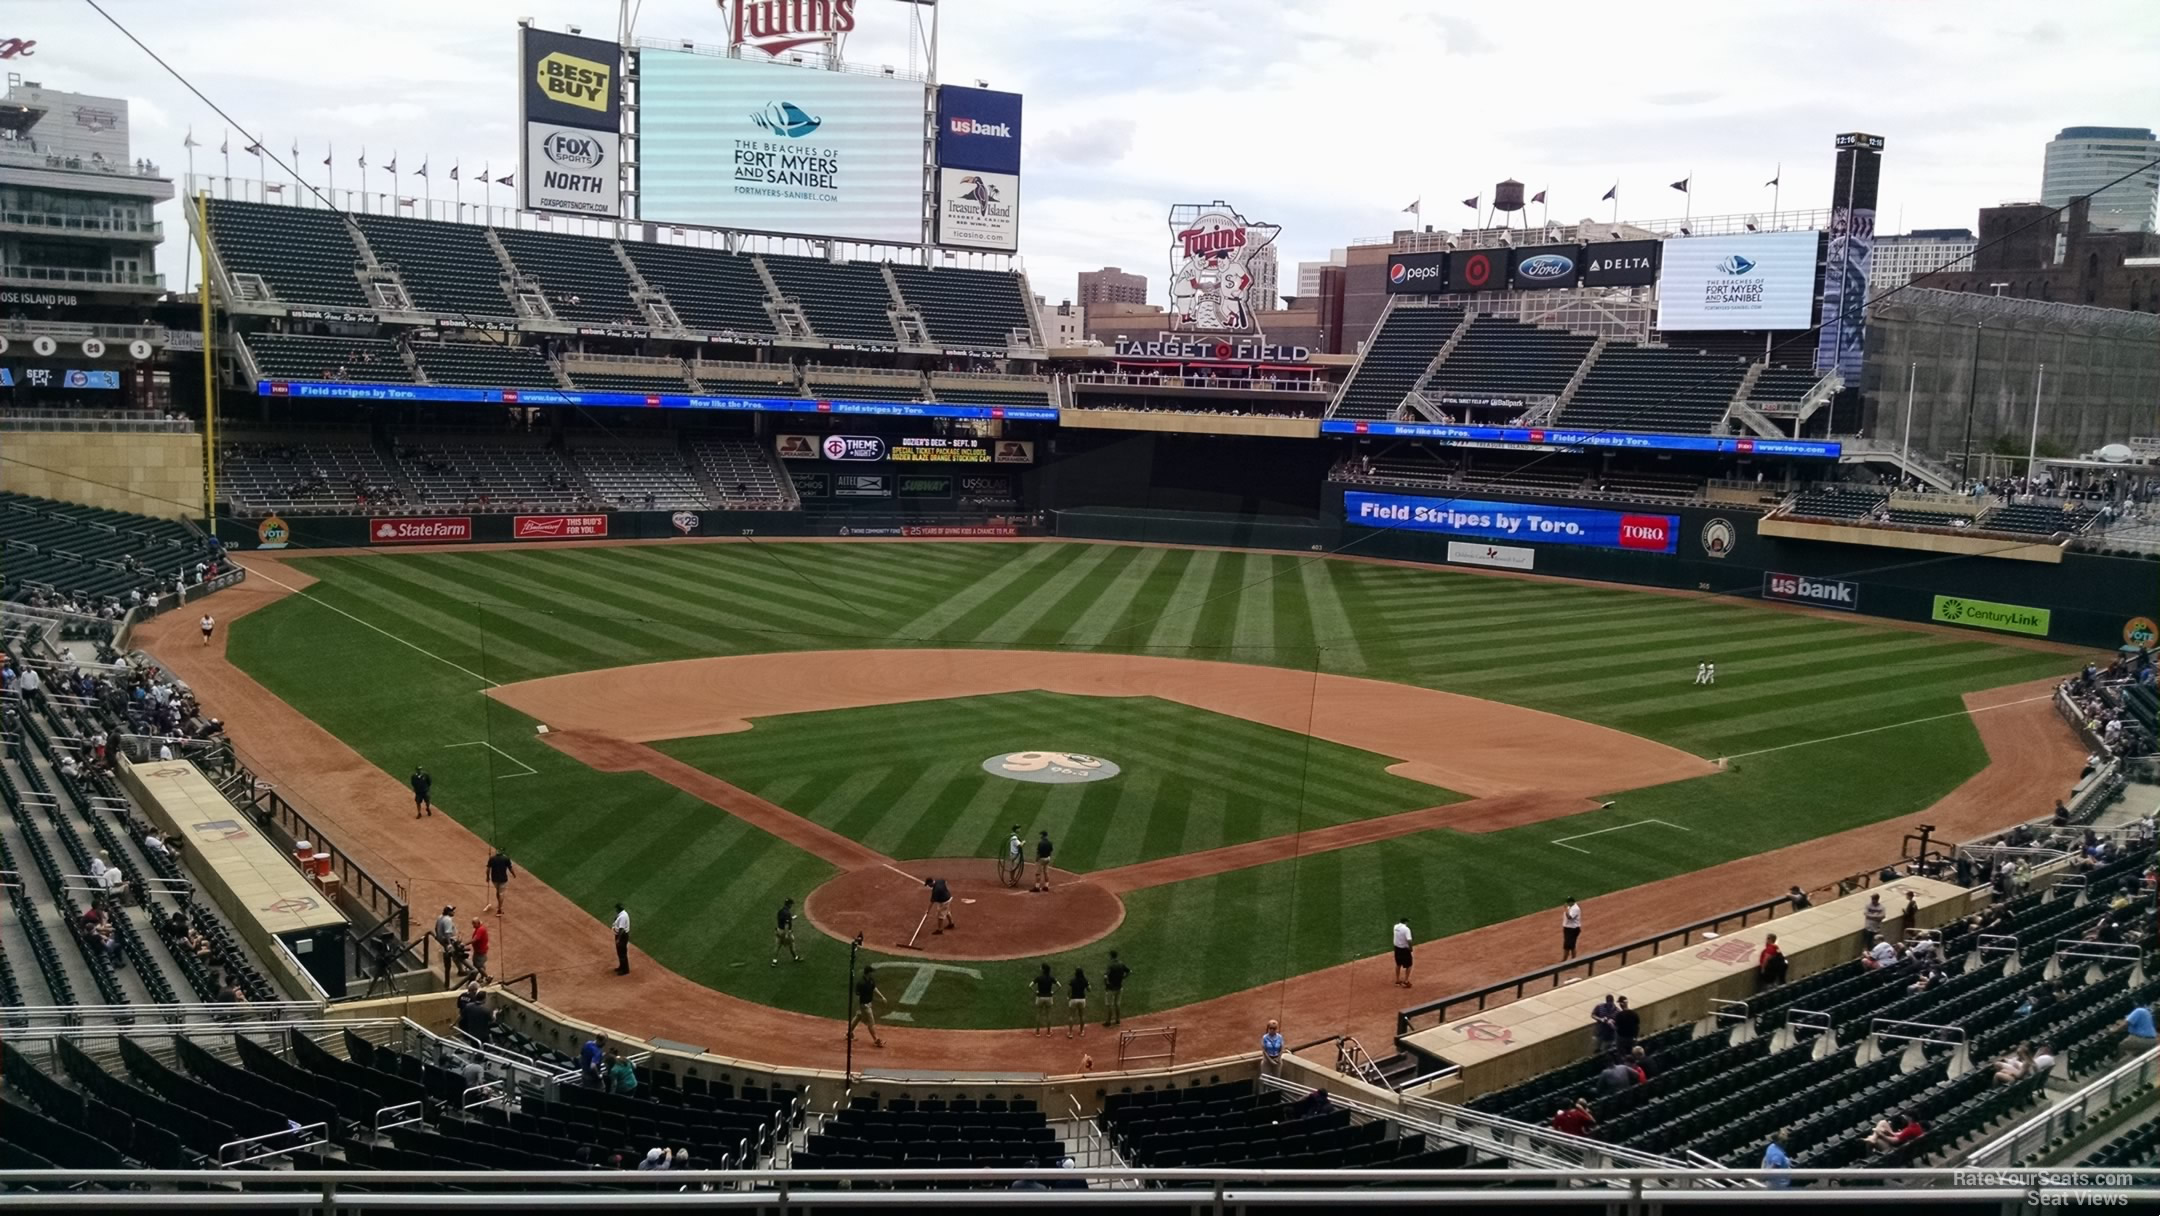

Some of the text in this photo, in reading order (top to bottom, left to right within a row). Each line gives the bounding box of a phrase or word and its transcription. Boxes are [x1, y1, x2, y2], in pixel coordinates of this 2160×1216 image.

[547, 60, 607, 88] BEST
[549, 76, 603, 102] BUY
[1837, 135, 1856, 145] 12:16
[556, 136, 591, 157] FOX
[735, 139, 838, 158] THE BEACHES OF
[556, 153, 592, 165] SPORTS
[735, 150, 838, 175] FORT MYERS
[543, 170, 603, 194] NORTH
[734, 166, 838, 190] AND SANIBEL
[734, 185, 838, 202] FORTMYERS-SANIBEL.COM
[540, 197, 608, 213] FOXSPORTSNORTH.COM
[947, 199, 1011, 218] Treasure Island
[953, 230, 1003, 241] ticasino.com
[1177, 224, 1248, 259] Twins
[1528, 260, 1562, 276] Ford
[1604, 258, 1650, 270] DELTA
[1407, 264, 1439, 281] pepsi
[1706, 284, 1764, 294] FORT MYERS
[21, 293, 56, 305] ISLAND
[58, 295, 77, 306] PUB
[1722, 294, 1763, 303] SANIBEL
[41, 341, 48, 352] 6
[87, 343, 100, 353] 29
[138, 344, 144, 355] 3
[1115, 340, 1311, 361] TARGET FIELD
[26, 368, 53, 379] SEPT.
[301, 386, 329, 395] Field
[332, 387, 372, 398] stripes
[373, 387, 386, 398] by
[388, 389, 416, 398] Toro.
[689, 399, 764, 409] Mow like the Pros.
[839, 404, 860, 412] Field
[861, 405, 891, 414] stripes
[893, 406, 902, 415] by
[903, 406, 925, 414] Toro.
[1415, 427, 1431, 435] like
[1448, 429, 1470, 437] Pros.
[846, 439, 879, 452] THEME
[953, 439, 970, 447] SEPT.
[971, 440, 978, 448] 10
[1553, 434, 1650, 446] Field stripes by Toro.
[1759, 444, 1825, 454] www.toro.com
[901, 479, 948, 491] SUBWAY
[567, 517, 602, 526] THIS BUD'S
[685, 516, 698, 526] 29
[1360, 502, 1585, 536] Field Stripes by Toro.
[567, 526, 596, 534] FOR YOU.
[911, 527, 921, 535] 25
[224, 541, 239, 549] 339
[1966, 606, 2039, 628] CenturyLink
